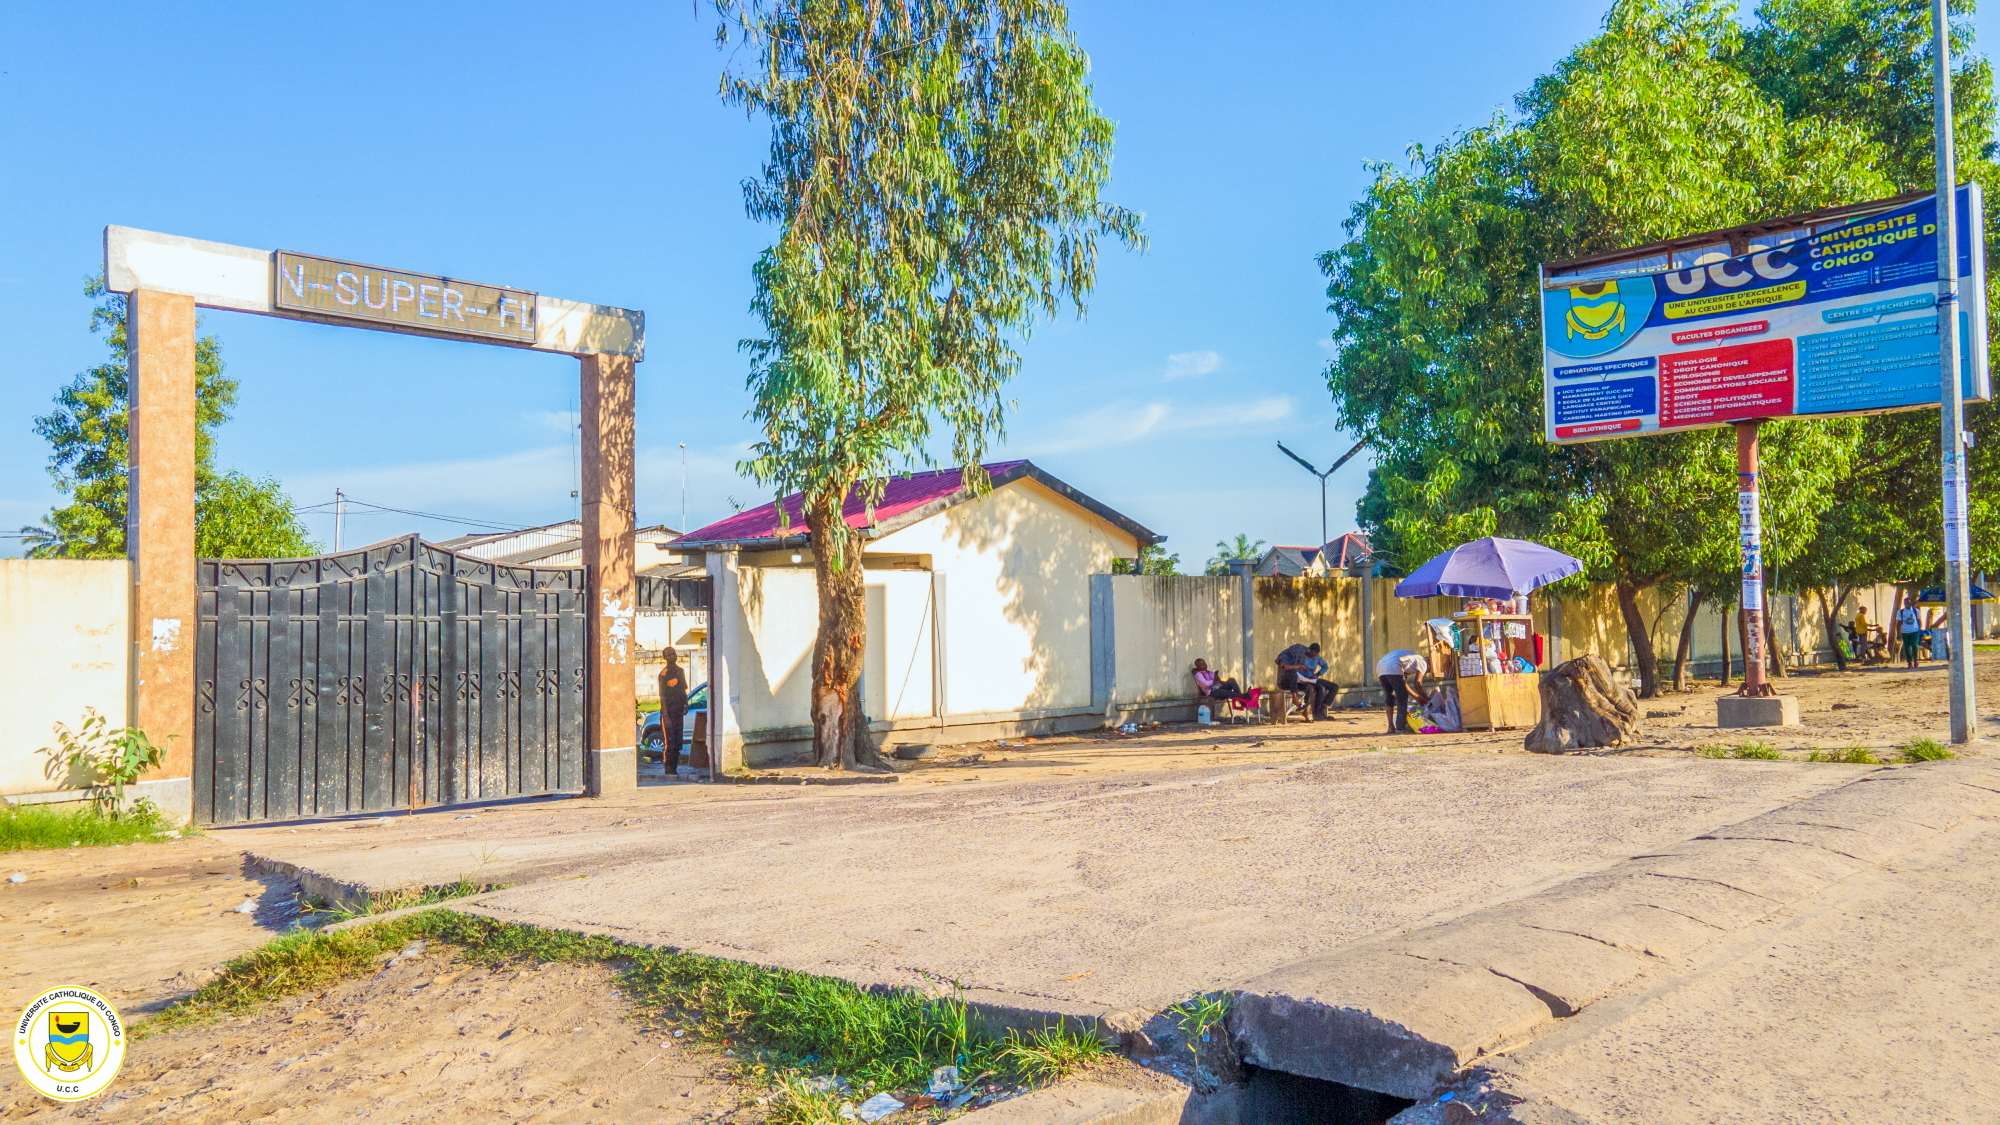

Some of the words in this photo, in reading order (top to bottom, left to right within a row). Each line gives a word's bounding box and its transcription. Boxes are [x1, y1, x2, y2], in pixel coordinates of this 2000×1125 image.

[1808, 213, 1916, 245] UNIVERSITE
[1810, 227, 1918, 258] CATHOLIQUE
[1923, 223, 1937, 236] D
[1665, 243, 1799, 295] UCC
[1811, 251, 1874, 271] CONGO
[1688, 295, 1735, 307] UNIVERSITE
[1738, 283, 1800, 299] D'EXCELLENCE
[1739, 295, 1783, 307] L'AFRIQUE
[1828, 309, 1860, 319] CENTRE
[1876, 298, 1928, 311] RECHERCHE
[1677, 331, 1713, 341] FACULTES
[1715, 325, 1763, 336] ORGANISEES
[1560, 366, 1602, 375] FORMATIONS
[1605, 360, 1648, 370] SPECIFIQUES
[1674, 357, 1717, 366] THEOLOGIE
[1700, 360, 1748, 370] CANONIQUE
[1674, 371, 1720, 380] PHILOSOPHIE
[1674, 379, 1711, 387] ECONOMIE
[1723, 369, 1787, 381] DEVELOPPEMENT
[1674, 381, 1746, 394] COMMUNICATIONS
[1748, 376, 1788, 385] SOCIALES
[1674, 399, 1712, 407] SCIENCES
[1714, 393, 1762, 403] POLITIQUES
[1674, 406, 1711, 414] SCIENCES
[1714, 398, 1782, 409] INFORMATIQUES
[1674, 412, 1714, 420] MEDECINE
[1573, 424, 1622, 433] BIBLIOTHEQUE
